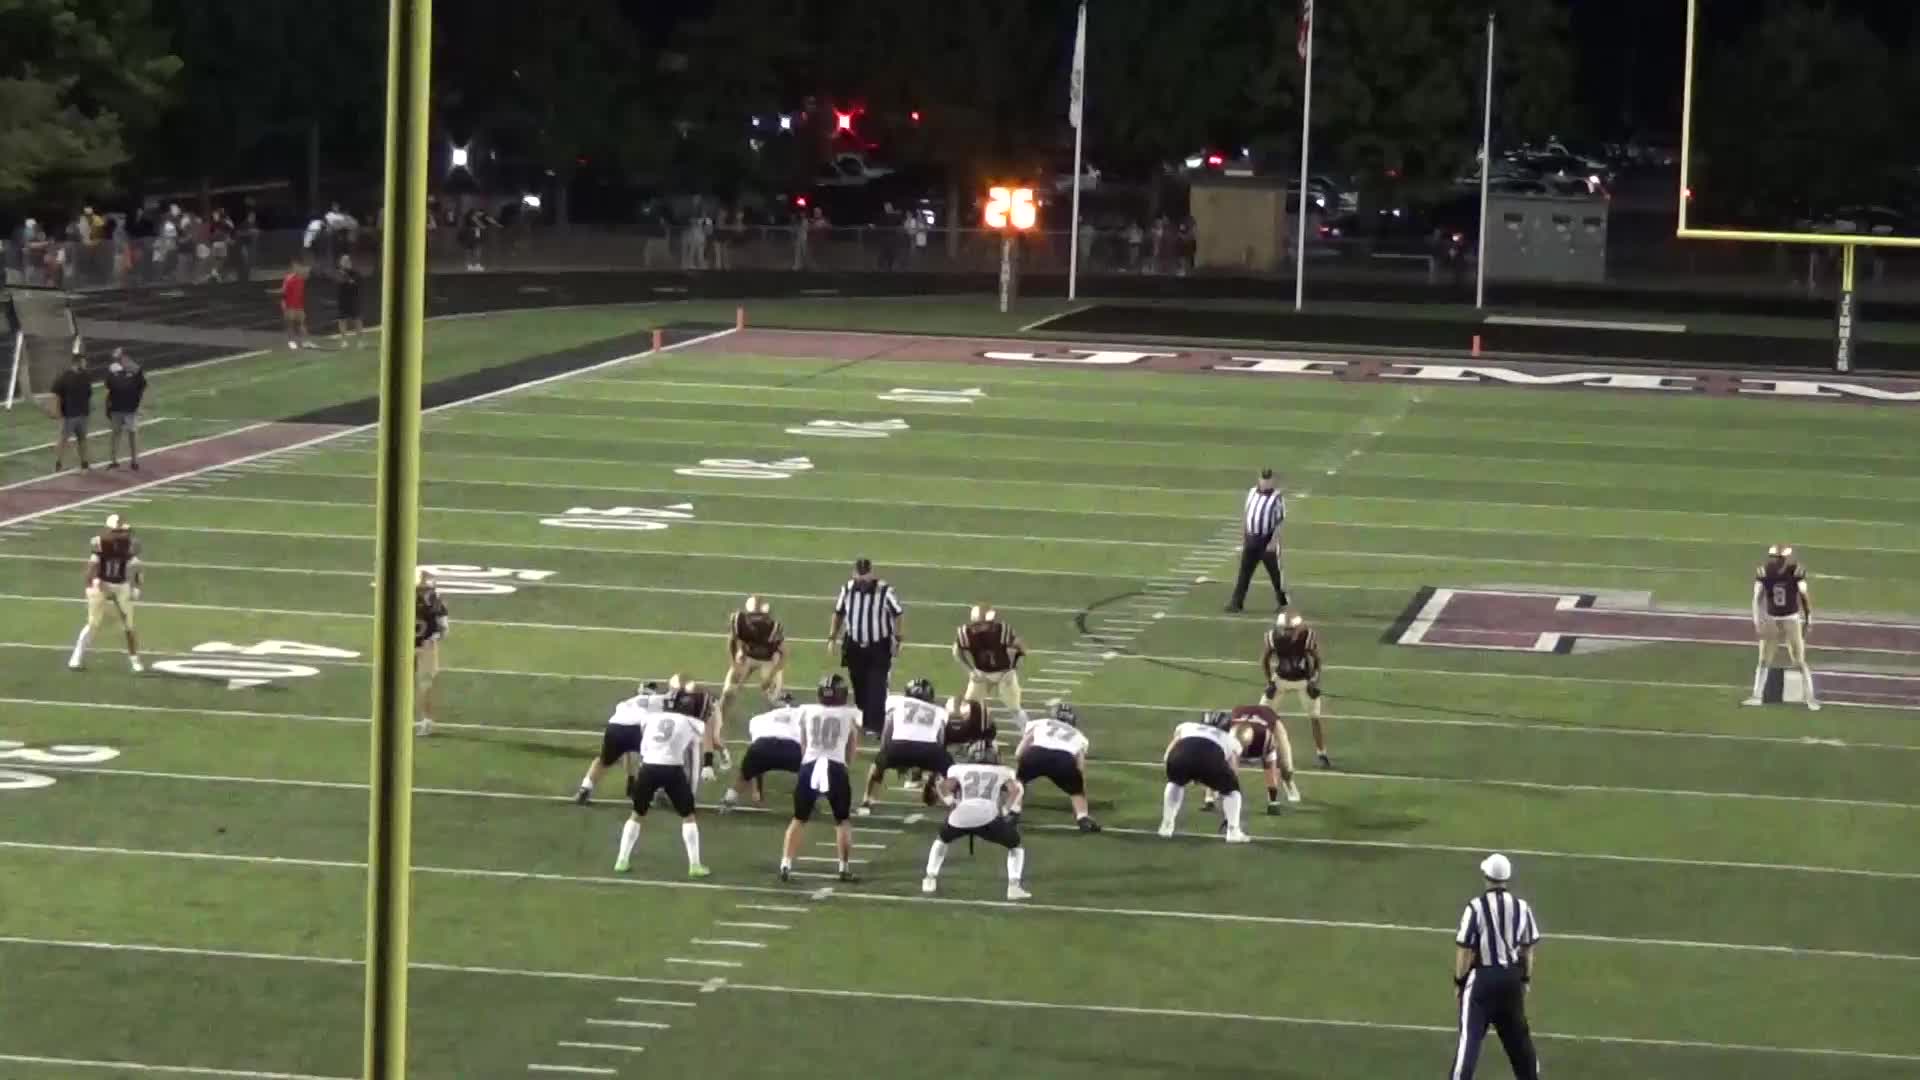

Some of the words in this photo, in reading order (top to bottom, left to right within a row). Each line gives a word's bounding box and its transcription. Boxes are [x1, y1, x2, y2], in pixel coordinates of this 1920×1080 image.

[985, 187, 1036, 229] 26
[151, 640, 361, 678] 40
[904, 701, 936, 727] 73
[653, 719, 675, 742] 9
[811, 716, 841, 750] 10
[964, 771, 998, 800] 27
